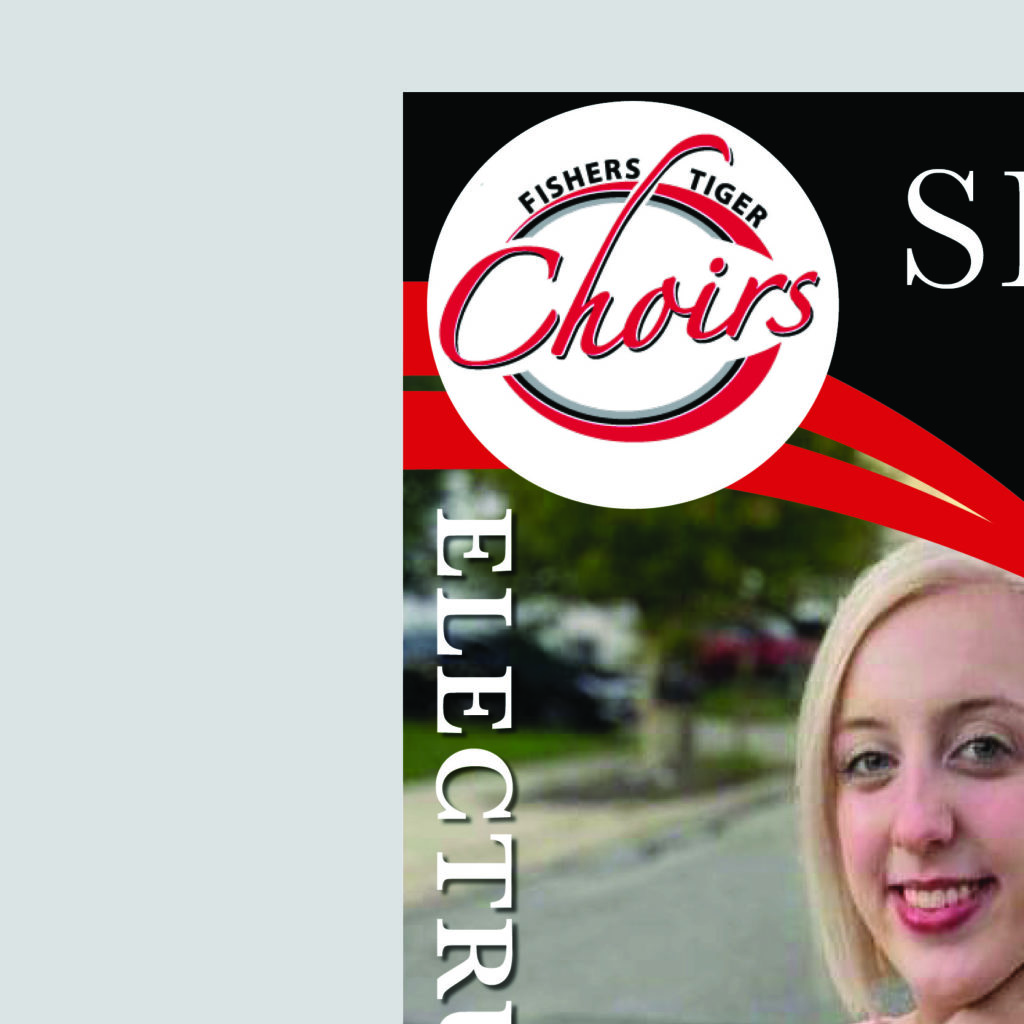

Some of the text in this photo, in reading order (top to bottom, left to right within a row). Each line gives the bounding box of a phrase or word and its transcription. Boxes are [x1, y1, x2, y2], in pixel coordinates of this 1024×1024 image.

[439, 133, 820, 370] Choirs
[518, 157, 768, 229] FISHERS TIGER
